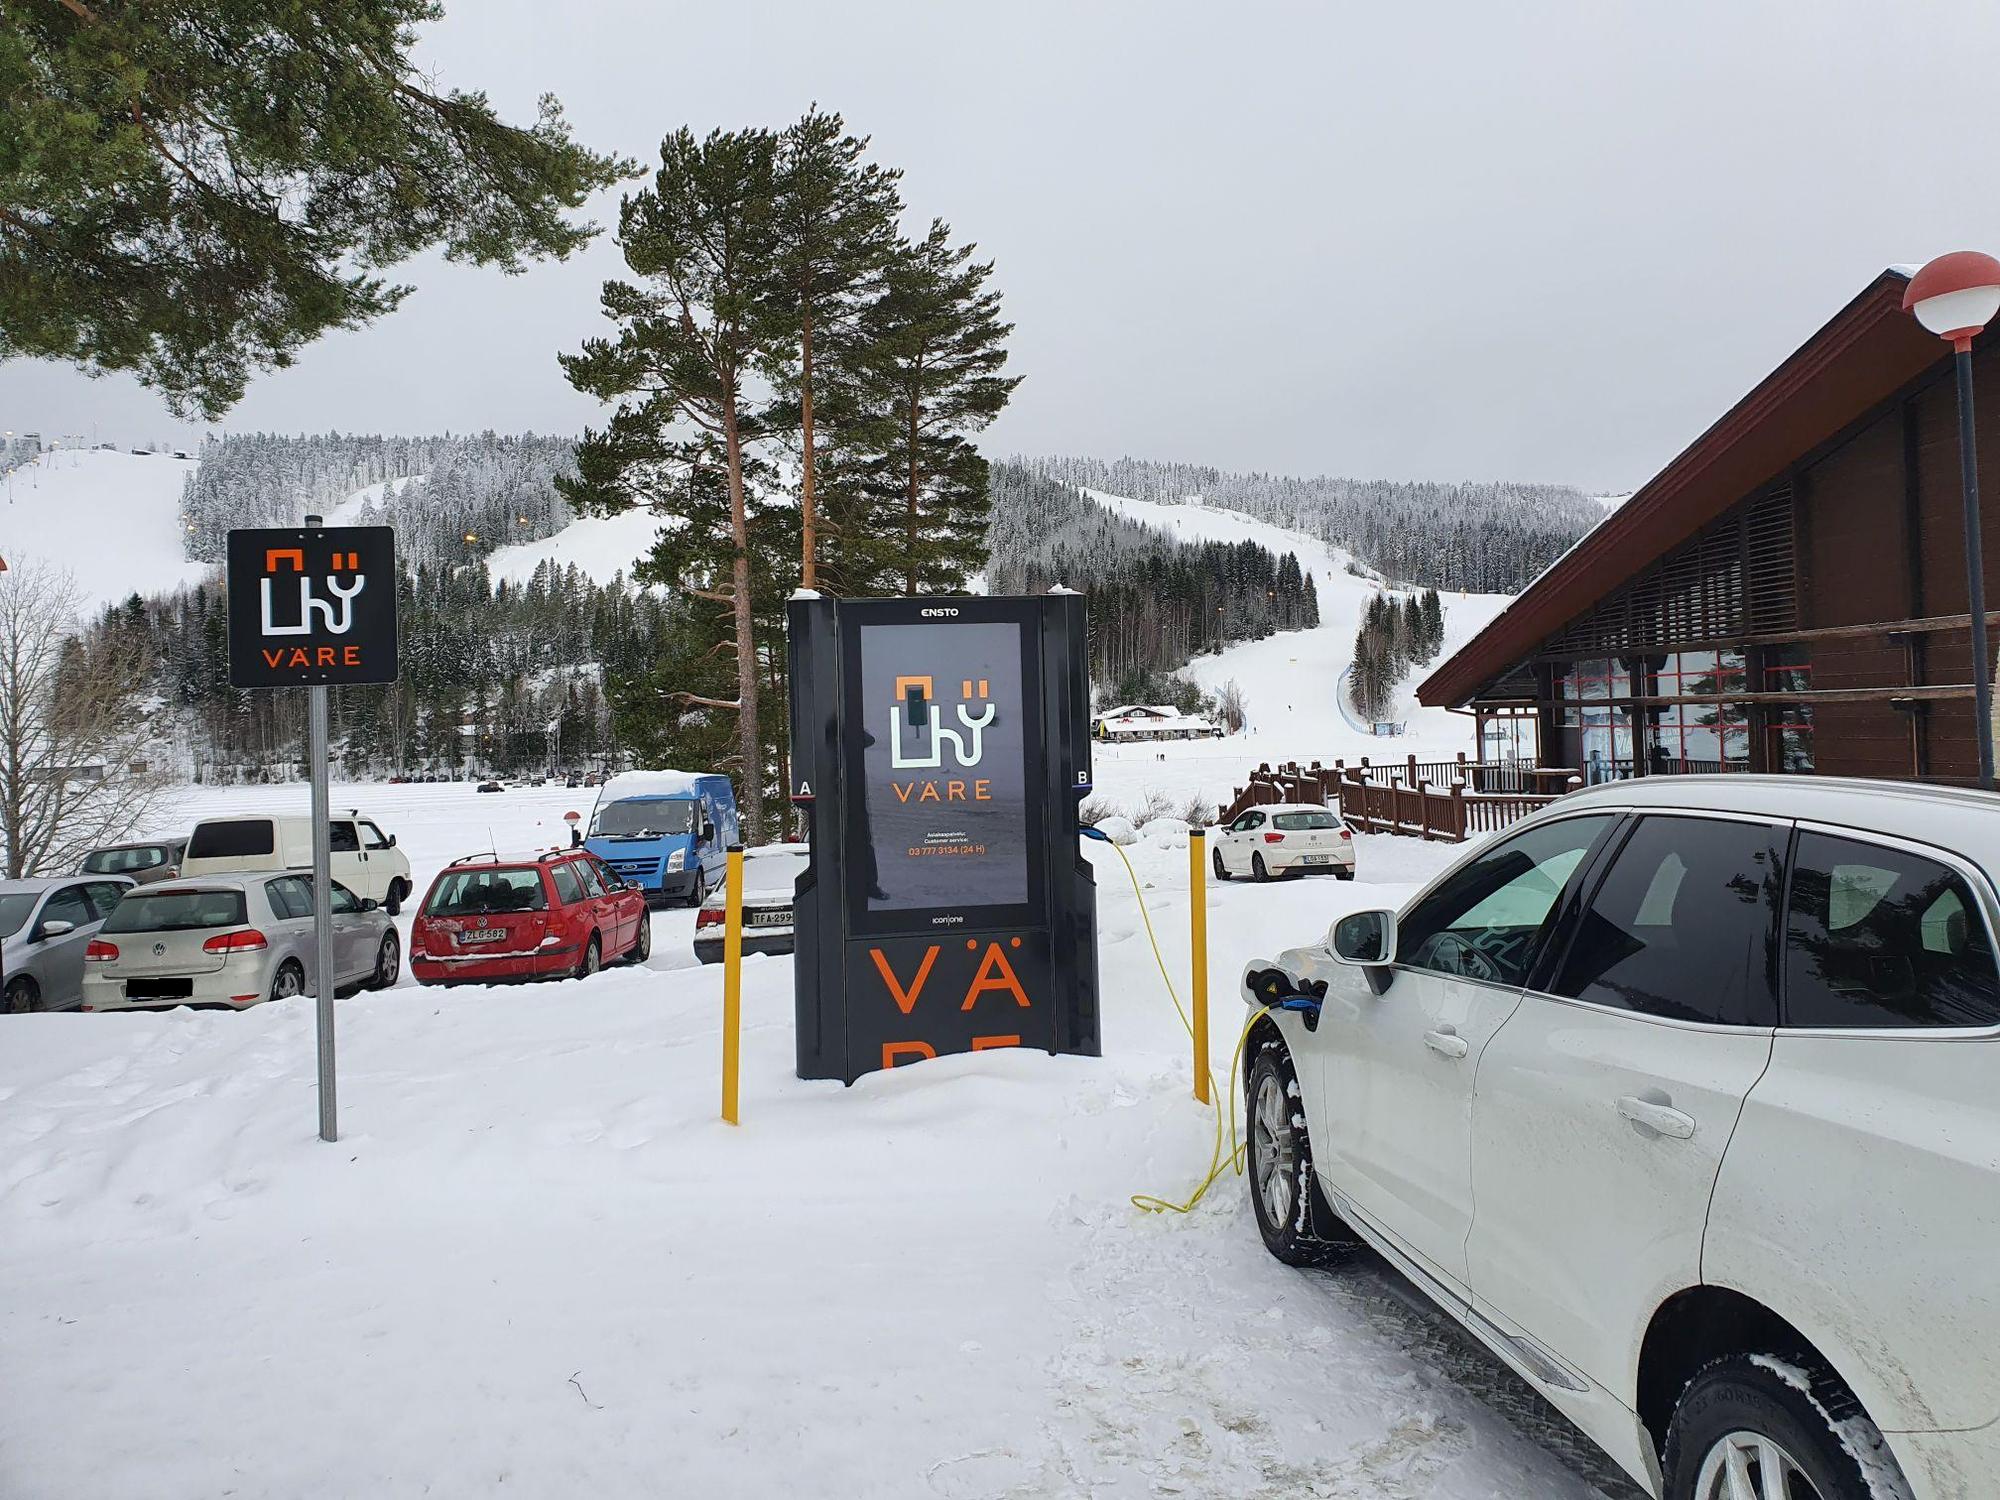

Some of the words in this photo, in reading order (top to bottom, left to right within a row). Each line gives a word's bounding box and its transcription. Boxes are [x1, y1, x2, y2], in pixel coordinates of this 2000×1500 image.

[921, 608, 959, 617] ENSTO
[262, 646, 361, 669] VÄRE
[1078, 771, 1087, 784] B
[800, 781, 811, 795] A
[892, 780, 992, 802] VÄRE
[909, 848, 920, 856] 03
[922, 847, 936, 855] 777
[938, 846, 958, 854] 3134
[960, 845, 973, 854] (24
[754, 913, 793, 923] TFA-299
[869, 936, 1032, 1014] VÄ
